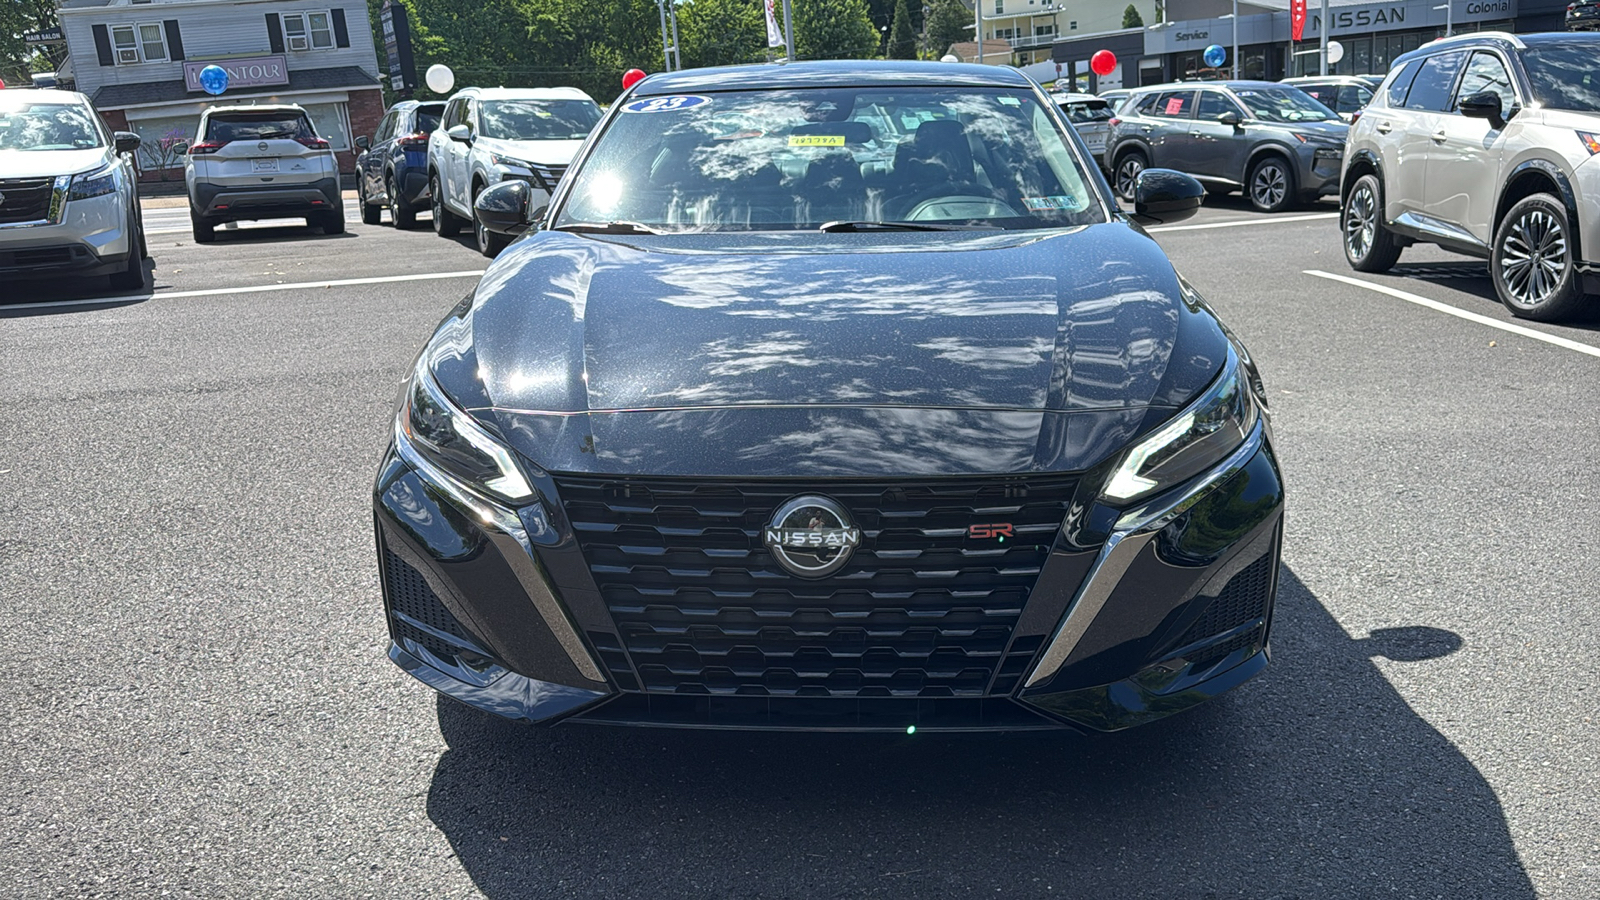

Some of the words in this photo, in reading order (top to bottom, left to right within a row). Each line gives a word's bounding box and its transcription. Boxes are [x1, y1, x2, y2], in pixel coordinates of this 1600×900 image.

[1466, 0, 1511, 14] Colonial
[41, 32, 61, 40] SALON
[1175, 30, 1208, 42] Service
[766, 531, 858, 544] NISSAN
[969, 523, 1014, 539] SR
